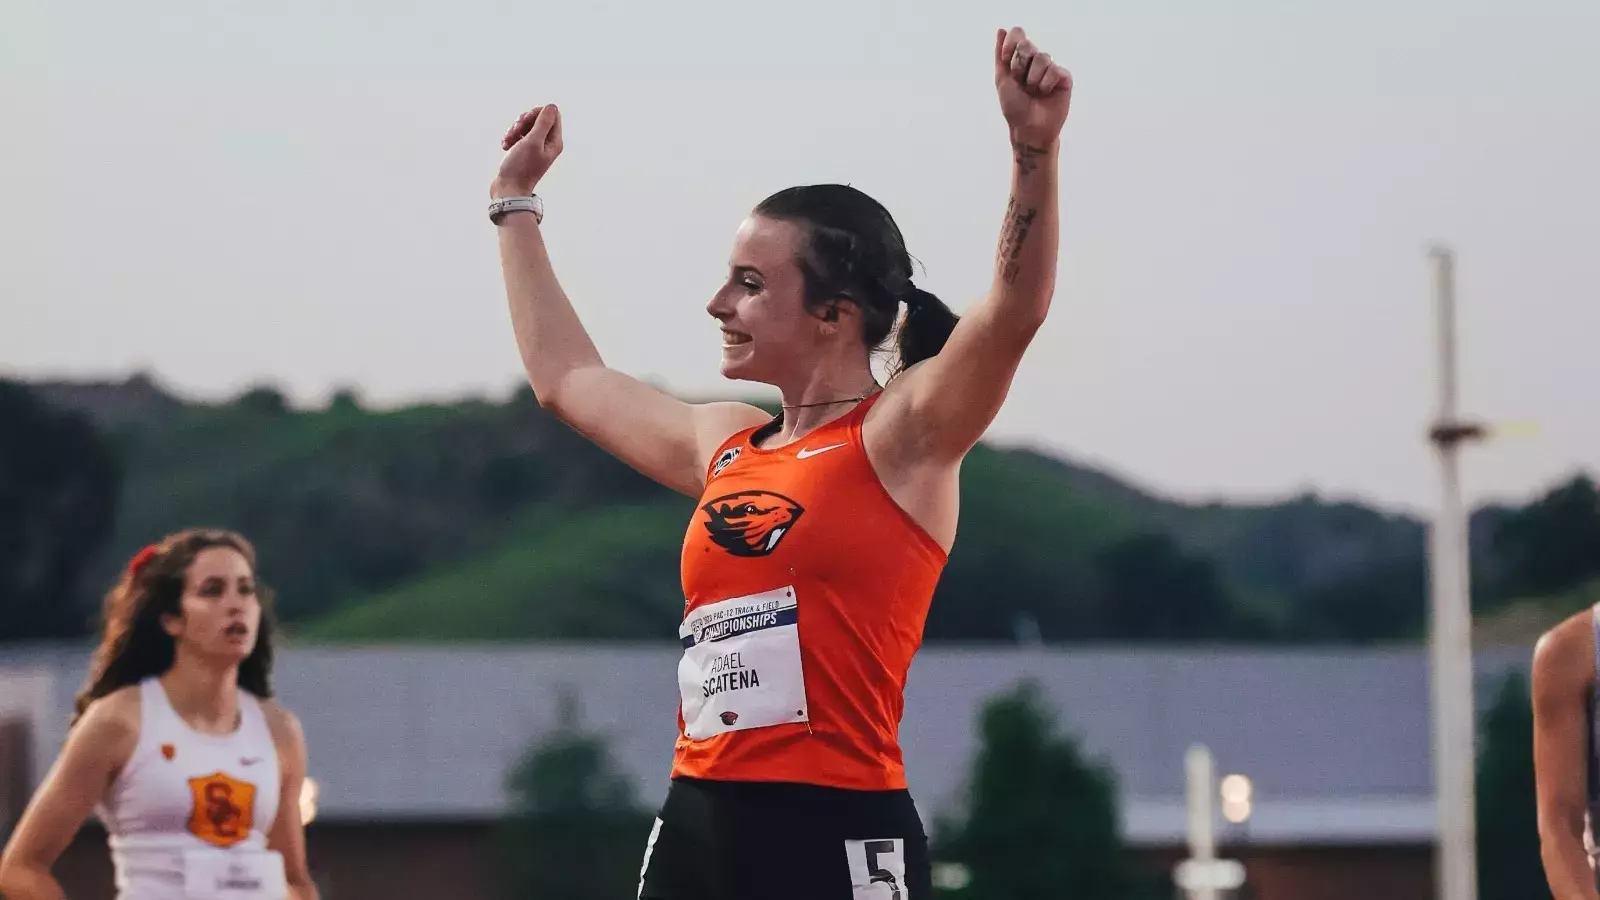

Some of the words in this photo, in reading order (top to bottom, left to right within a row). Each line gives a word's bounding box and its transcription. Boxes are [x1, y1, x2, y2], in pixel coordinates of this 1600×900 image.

[713, 609, 734, 621] PAC-12
[735, 605, 755, 615] TRACK
[756, 604, 761, 612] &
[762, 600, 780, 611] FIELD
[703, 612, 777, 641] CHAMPIONSHIPS
[711, 652, 746, 673] ADAEL
[702, 669, 760, 698] SCATENA
[863, 840, 902, 900] 5
